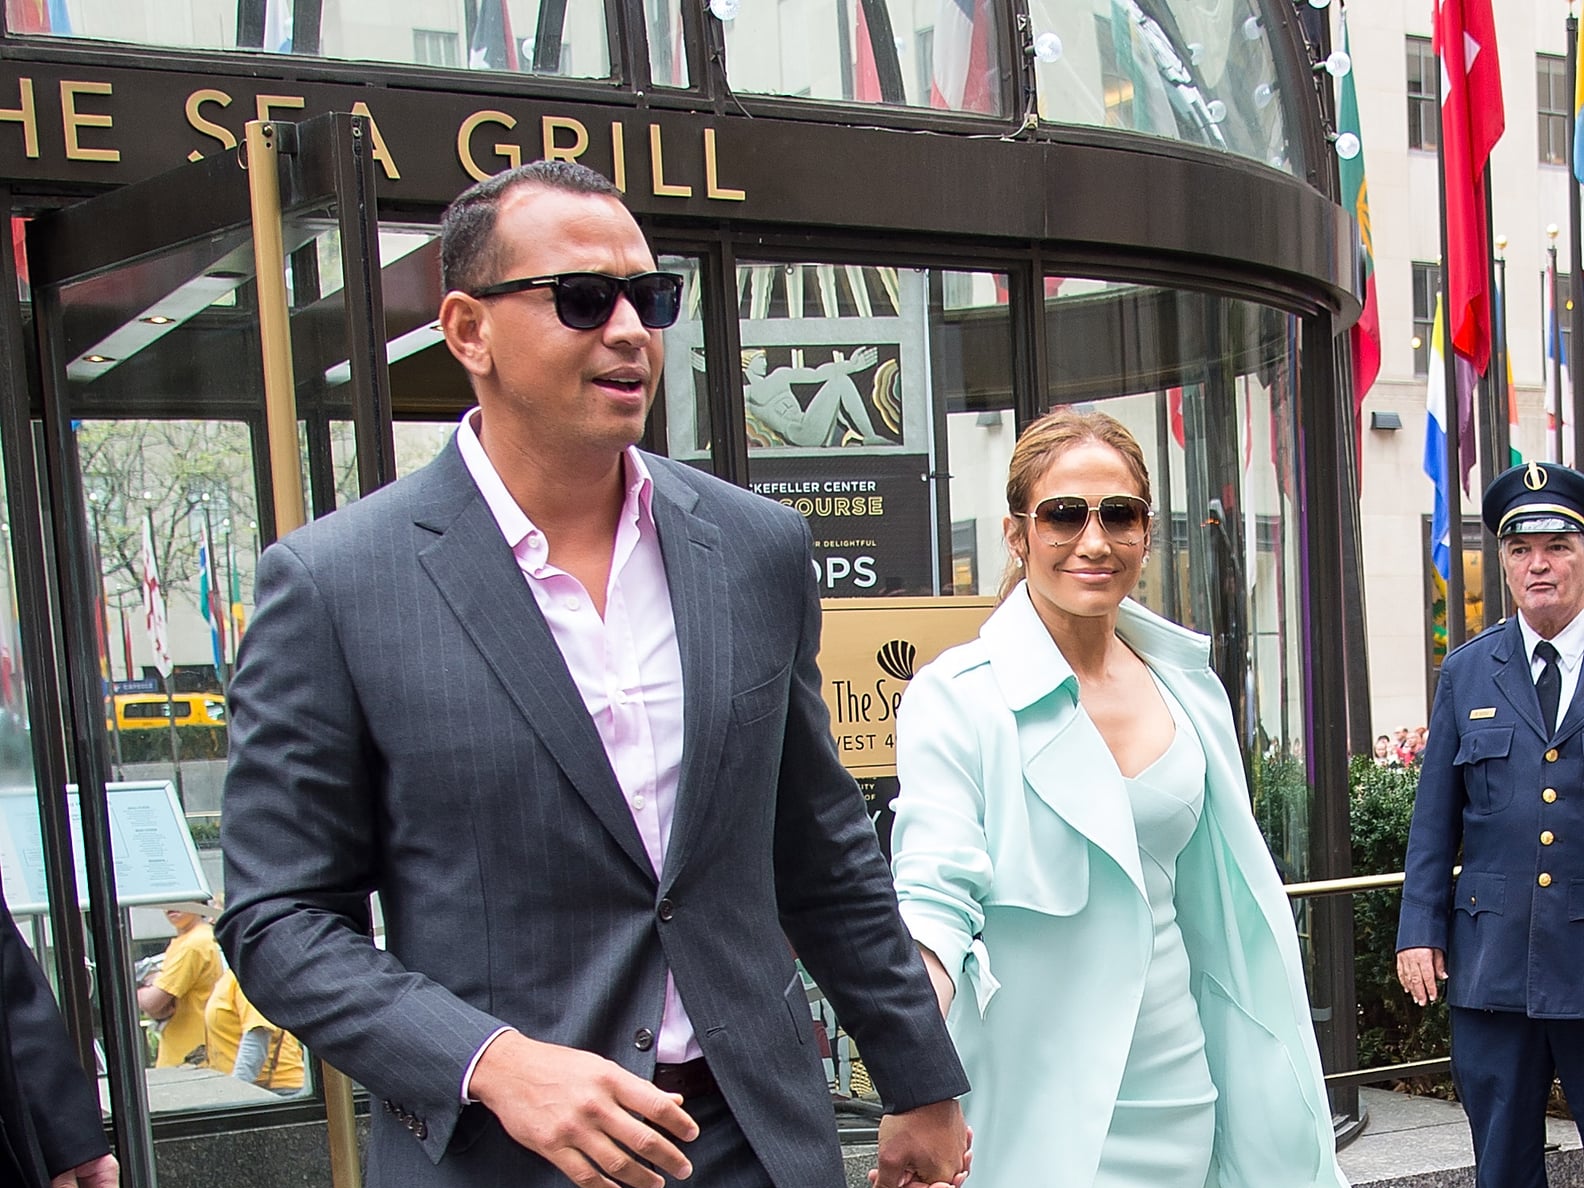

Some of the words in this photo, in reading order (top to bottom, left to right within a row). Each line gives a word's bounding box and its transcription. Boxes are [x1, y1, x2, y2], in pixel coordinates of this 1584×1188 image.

[457, 110, 746, 201] GRILL
[749, 482, 820, 494] KEFELLER
[823, 481, 876, 493] CENTER
[811, 556, 877, 588] PS
[832, 680, 871, 723] The
